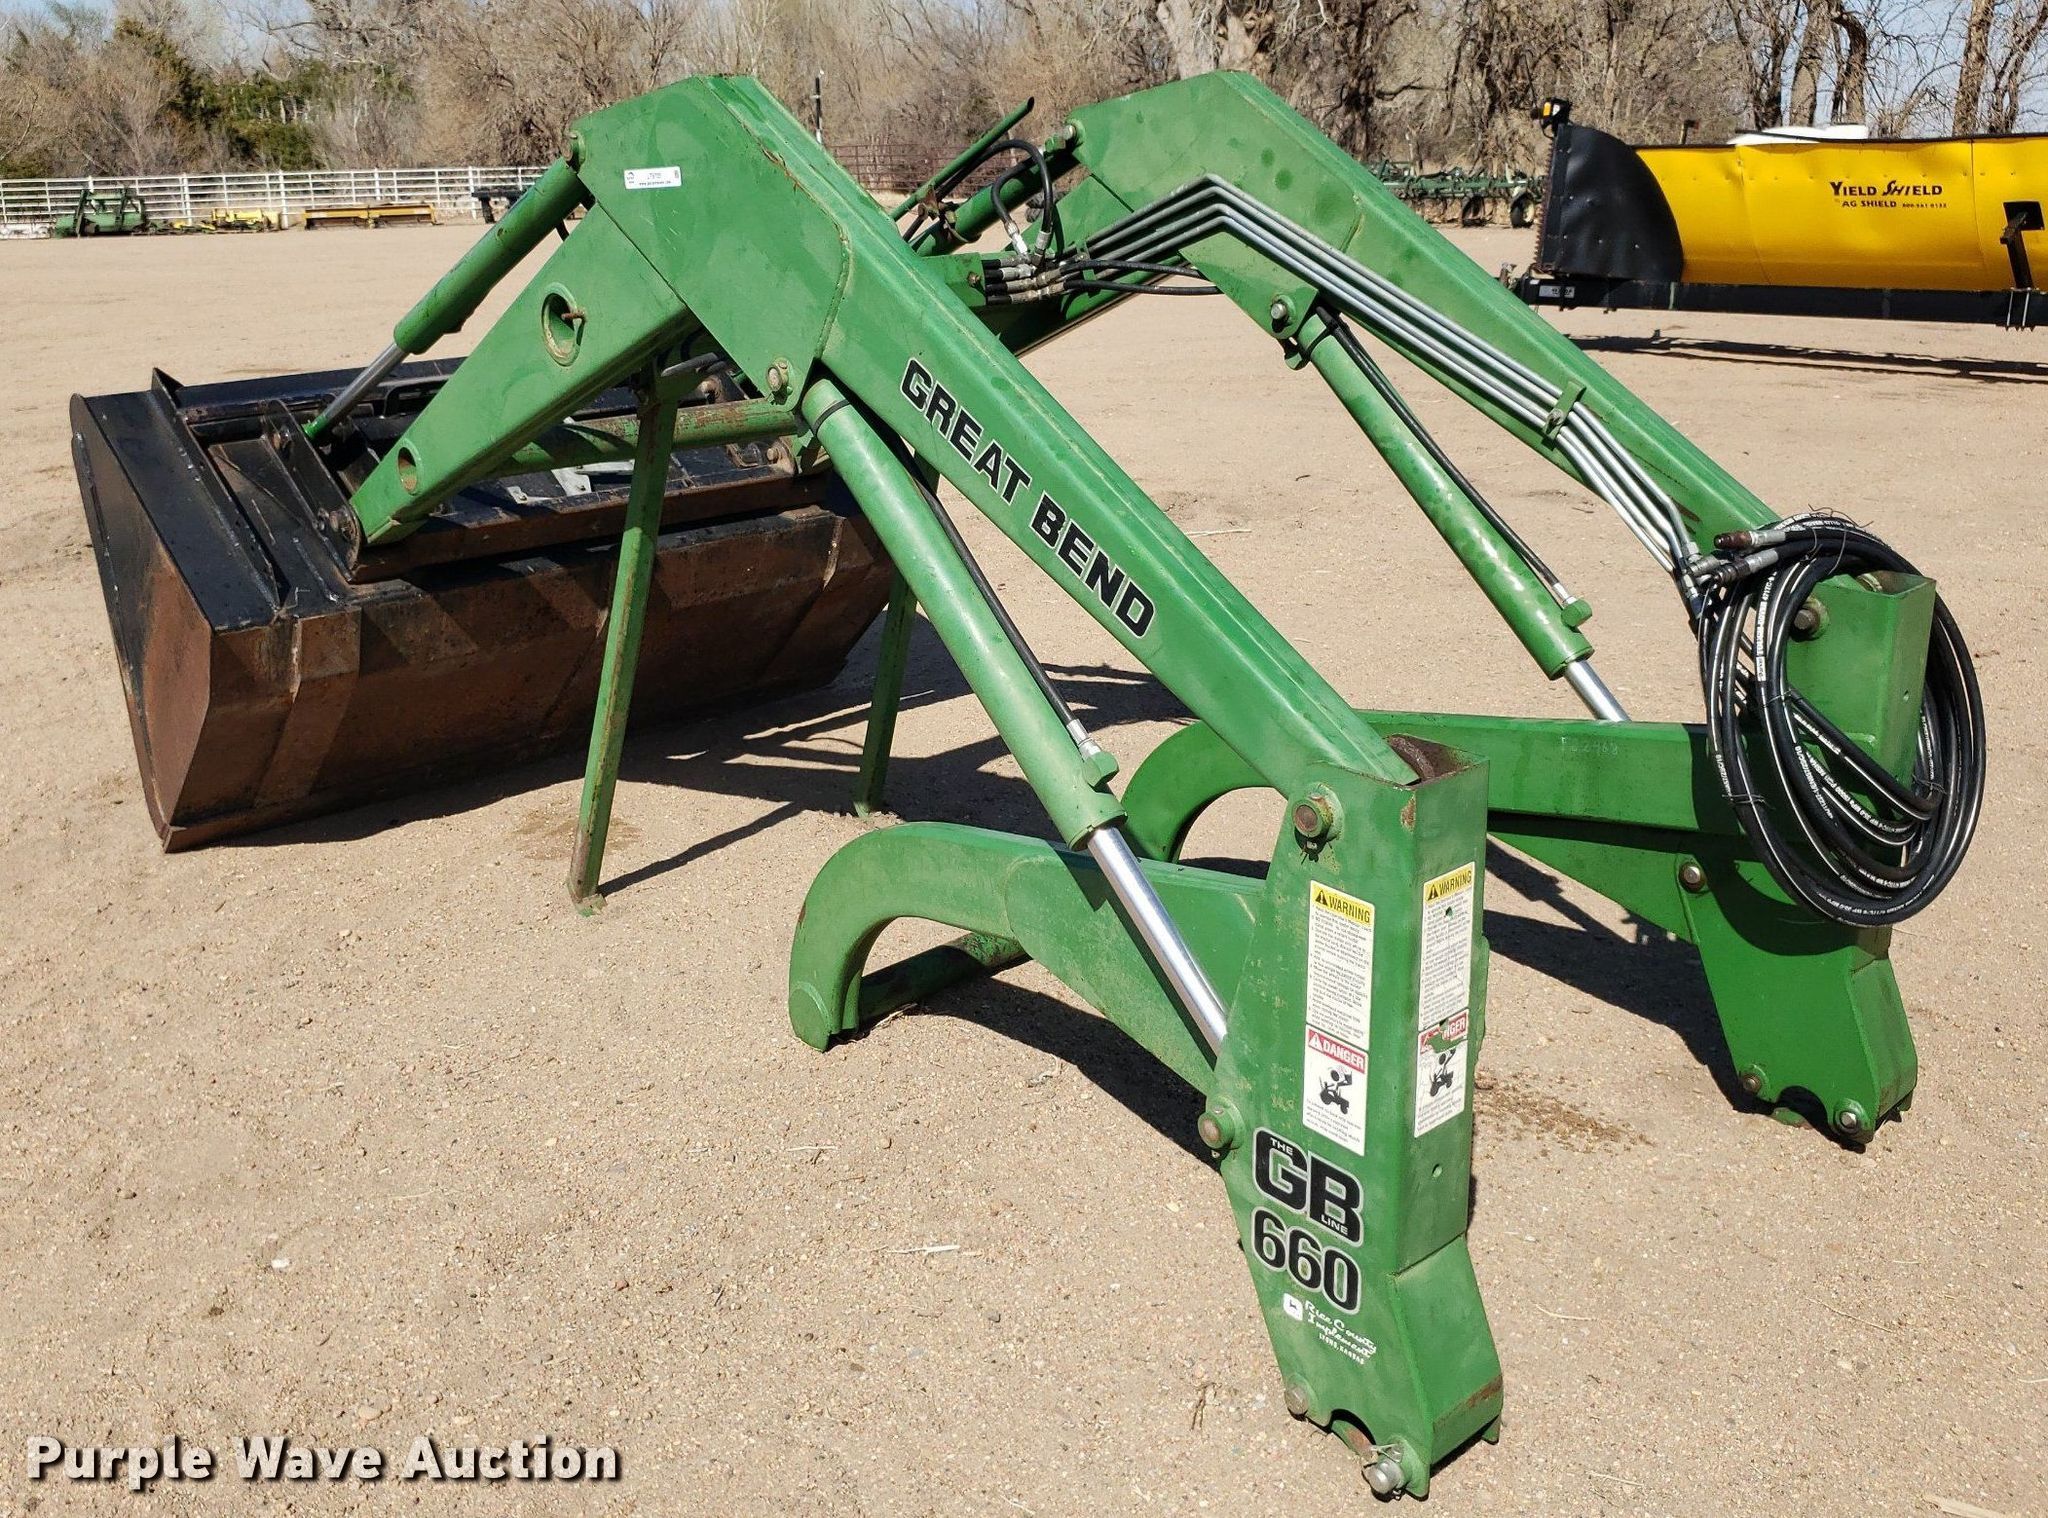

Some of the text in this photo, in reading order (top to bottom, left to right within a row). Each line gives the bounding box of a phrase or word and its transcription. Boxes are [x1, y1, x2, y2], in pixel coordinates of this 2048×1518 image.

[1829, 179, 1943, 196] YIELD SHIELD
[1861, 200, 1897, 208] SHIELD
[900, 357, 1155, 639] GREAT BEND
[1439, 869, 1472, 896] WARNING
[1328, 893, 1371, 924] WARNING
[1322, 1038, 1365, 1072] DANGER
[1270, 1137, 1293, 1155] THE
[1253, 1127, 1363, 1247] GB
[1321, 1213, 1348, 1236] LINE
[1251, 1206, 1361, 1315] 660
